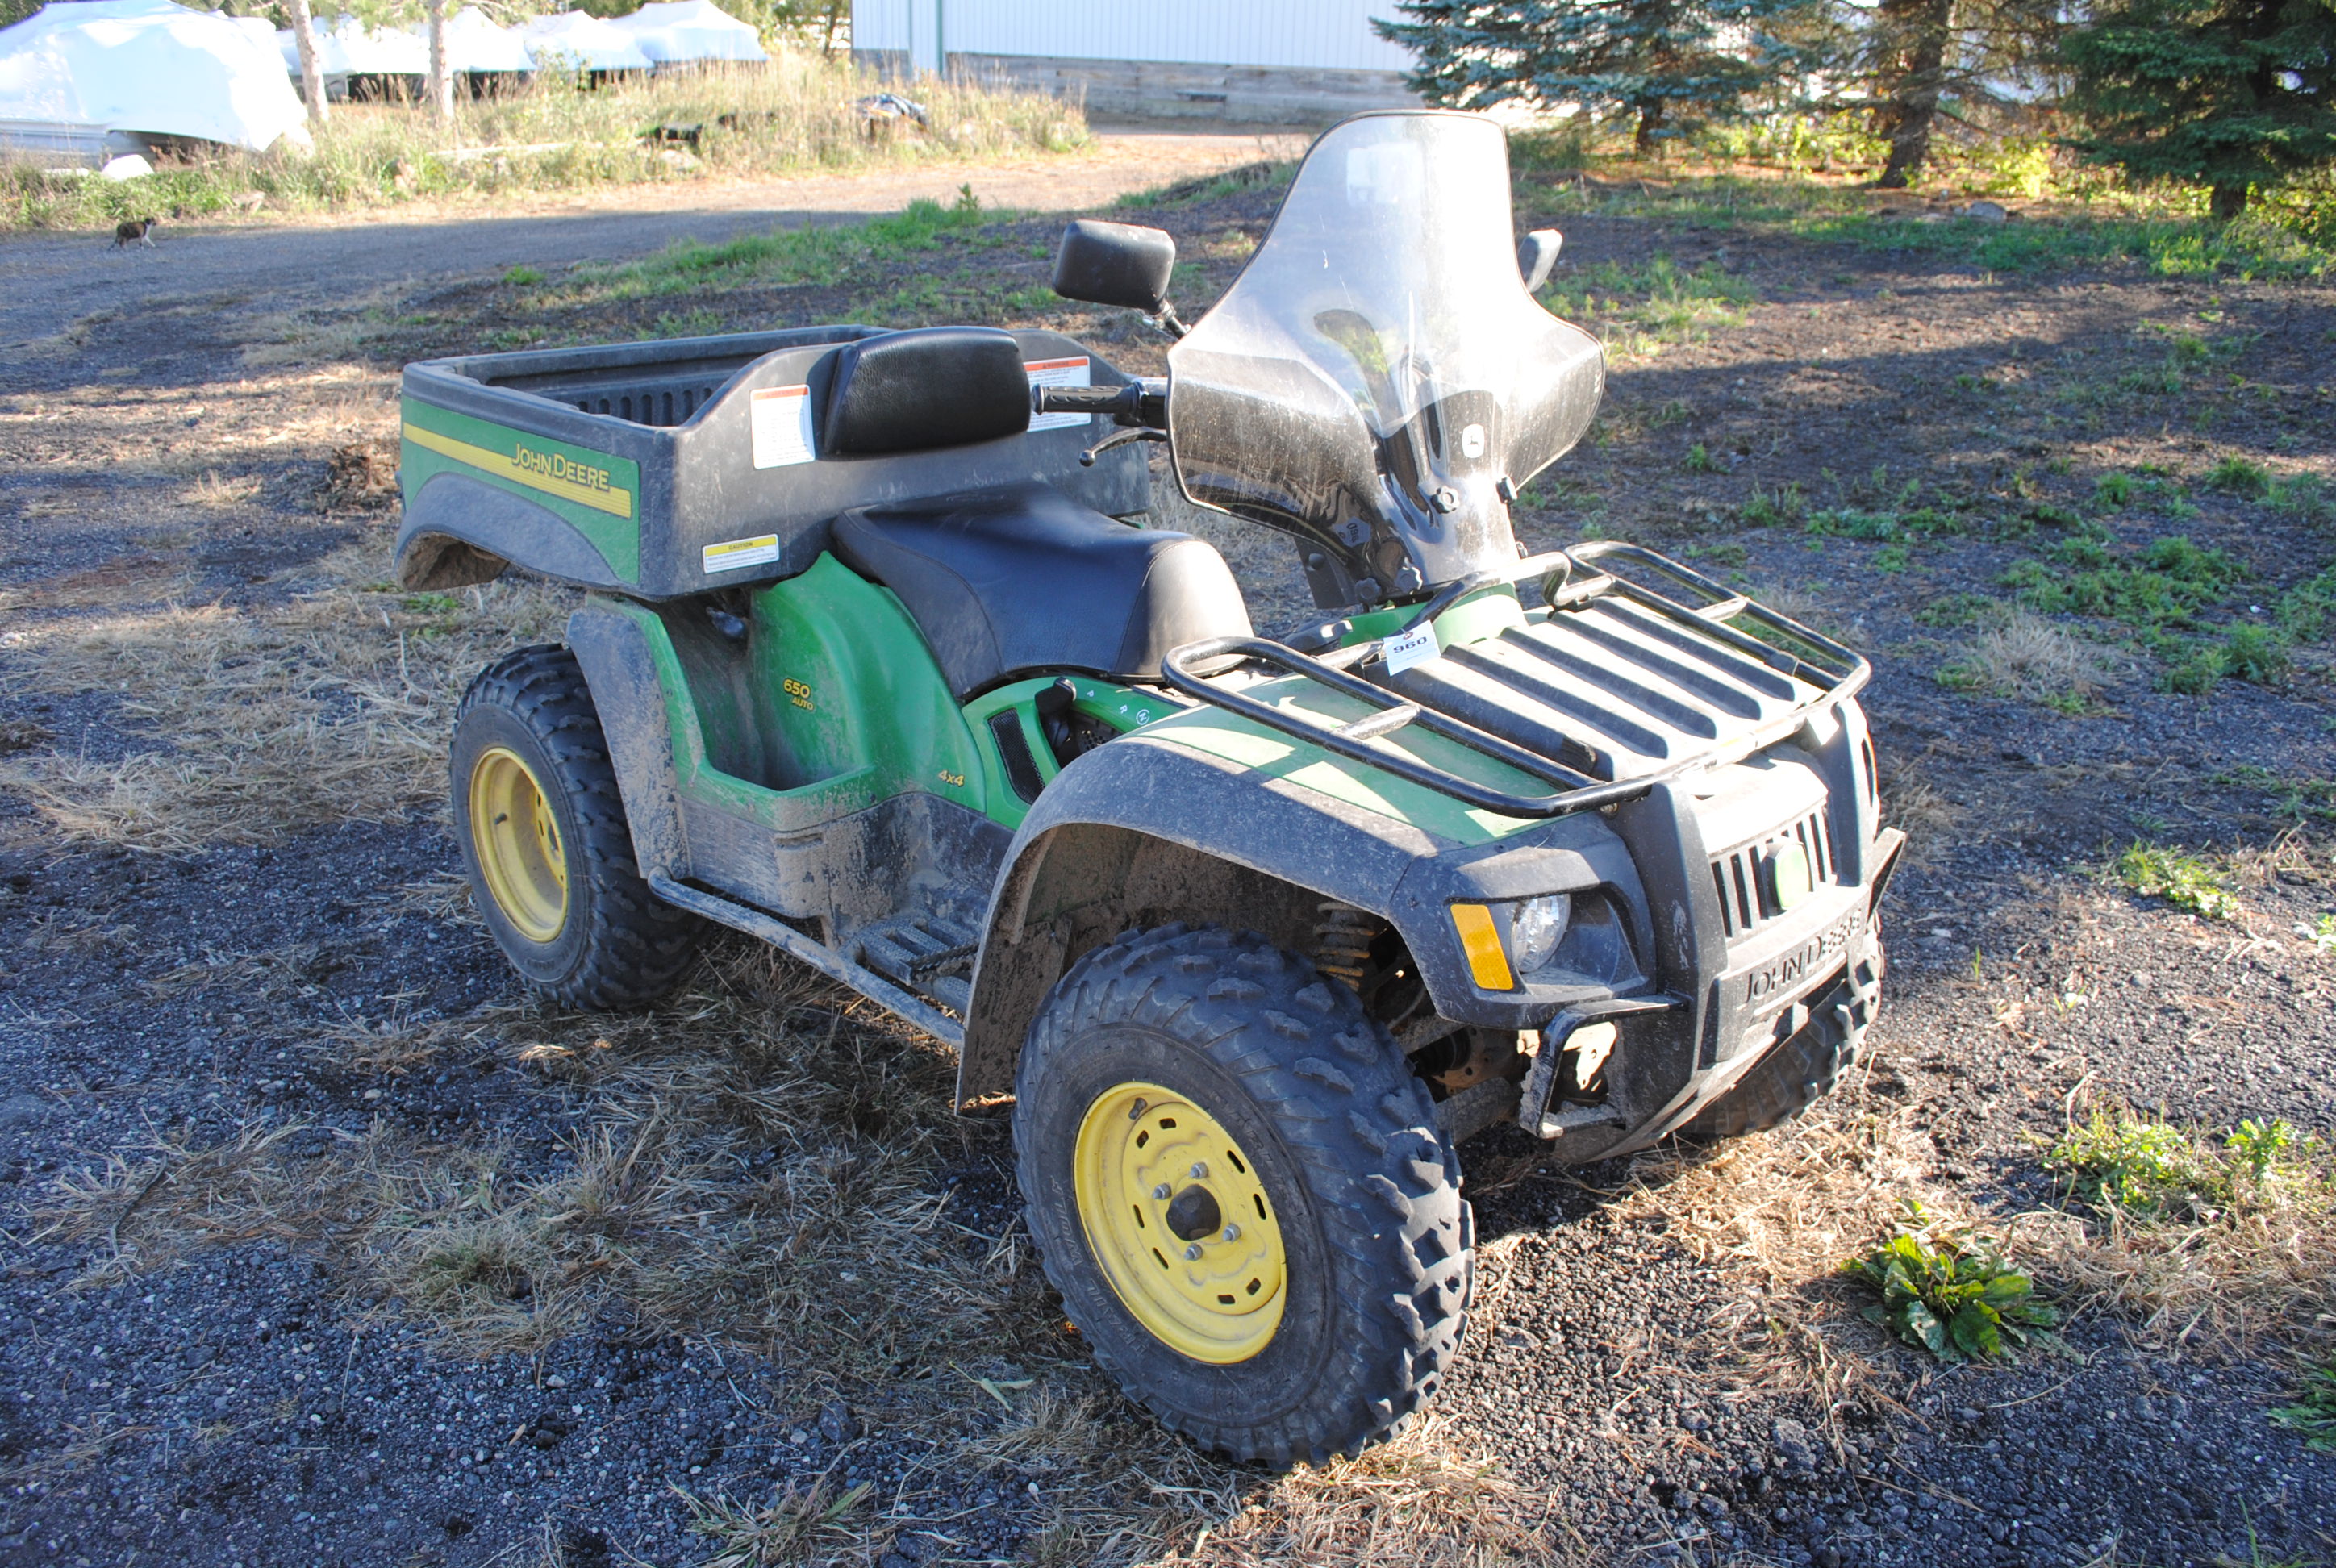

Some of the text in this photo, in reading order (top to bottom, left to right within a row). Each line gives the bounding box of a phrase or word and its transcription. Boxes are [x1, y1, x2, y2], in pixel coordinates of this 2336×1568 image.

[511, 442, 610, 493] JOHN DEERE
[728, 542, 753, 550] CAUTION
[1393, 636, 1427, 653] 960
[783, 678, 811, 699] 650
[791, 696, 814, 711] AUTO
[1086, 690, 1095, 698] P
[1120, 704, 1128, 715] R
[937, 769, 964, 787] 4x4
[1737, 951, 1805, 1010] JOHN
